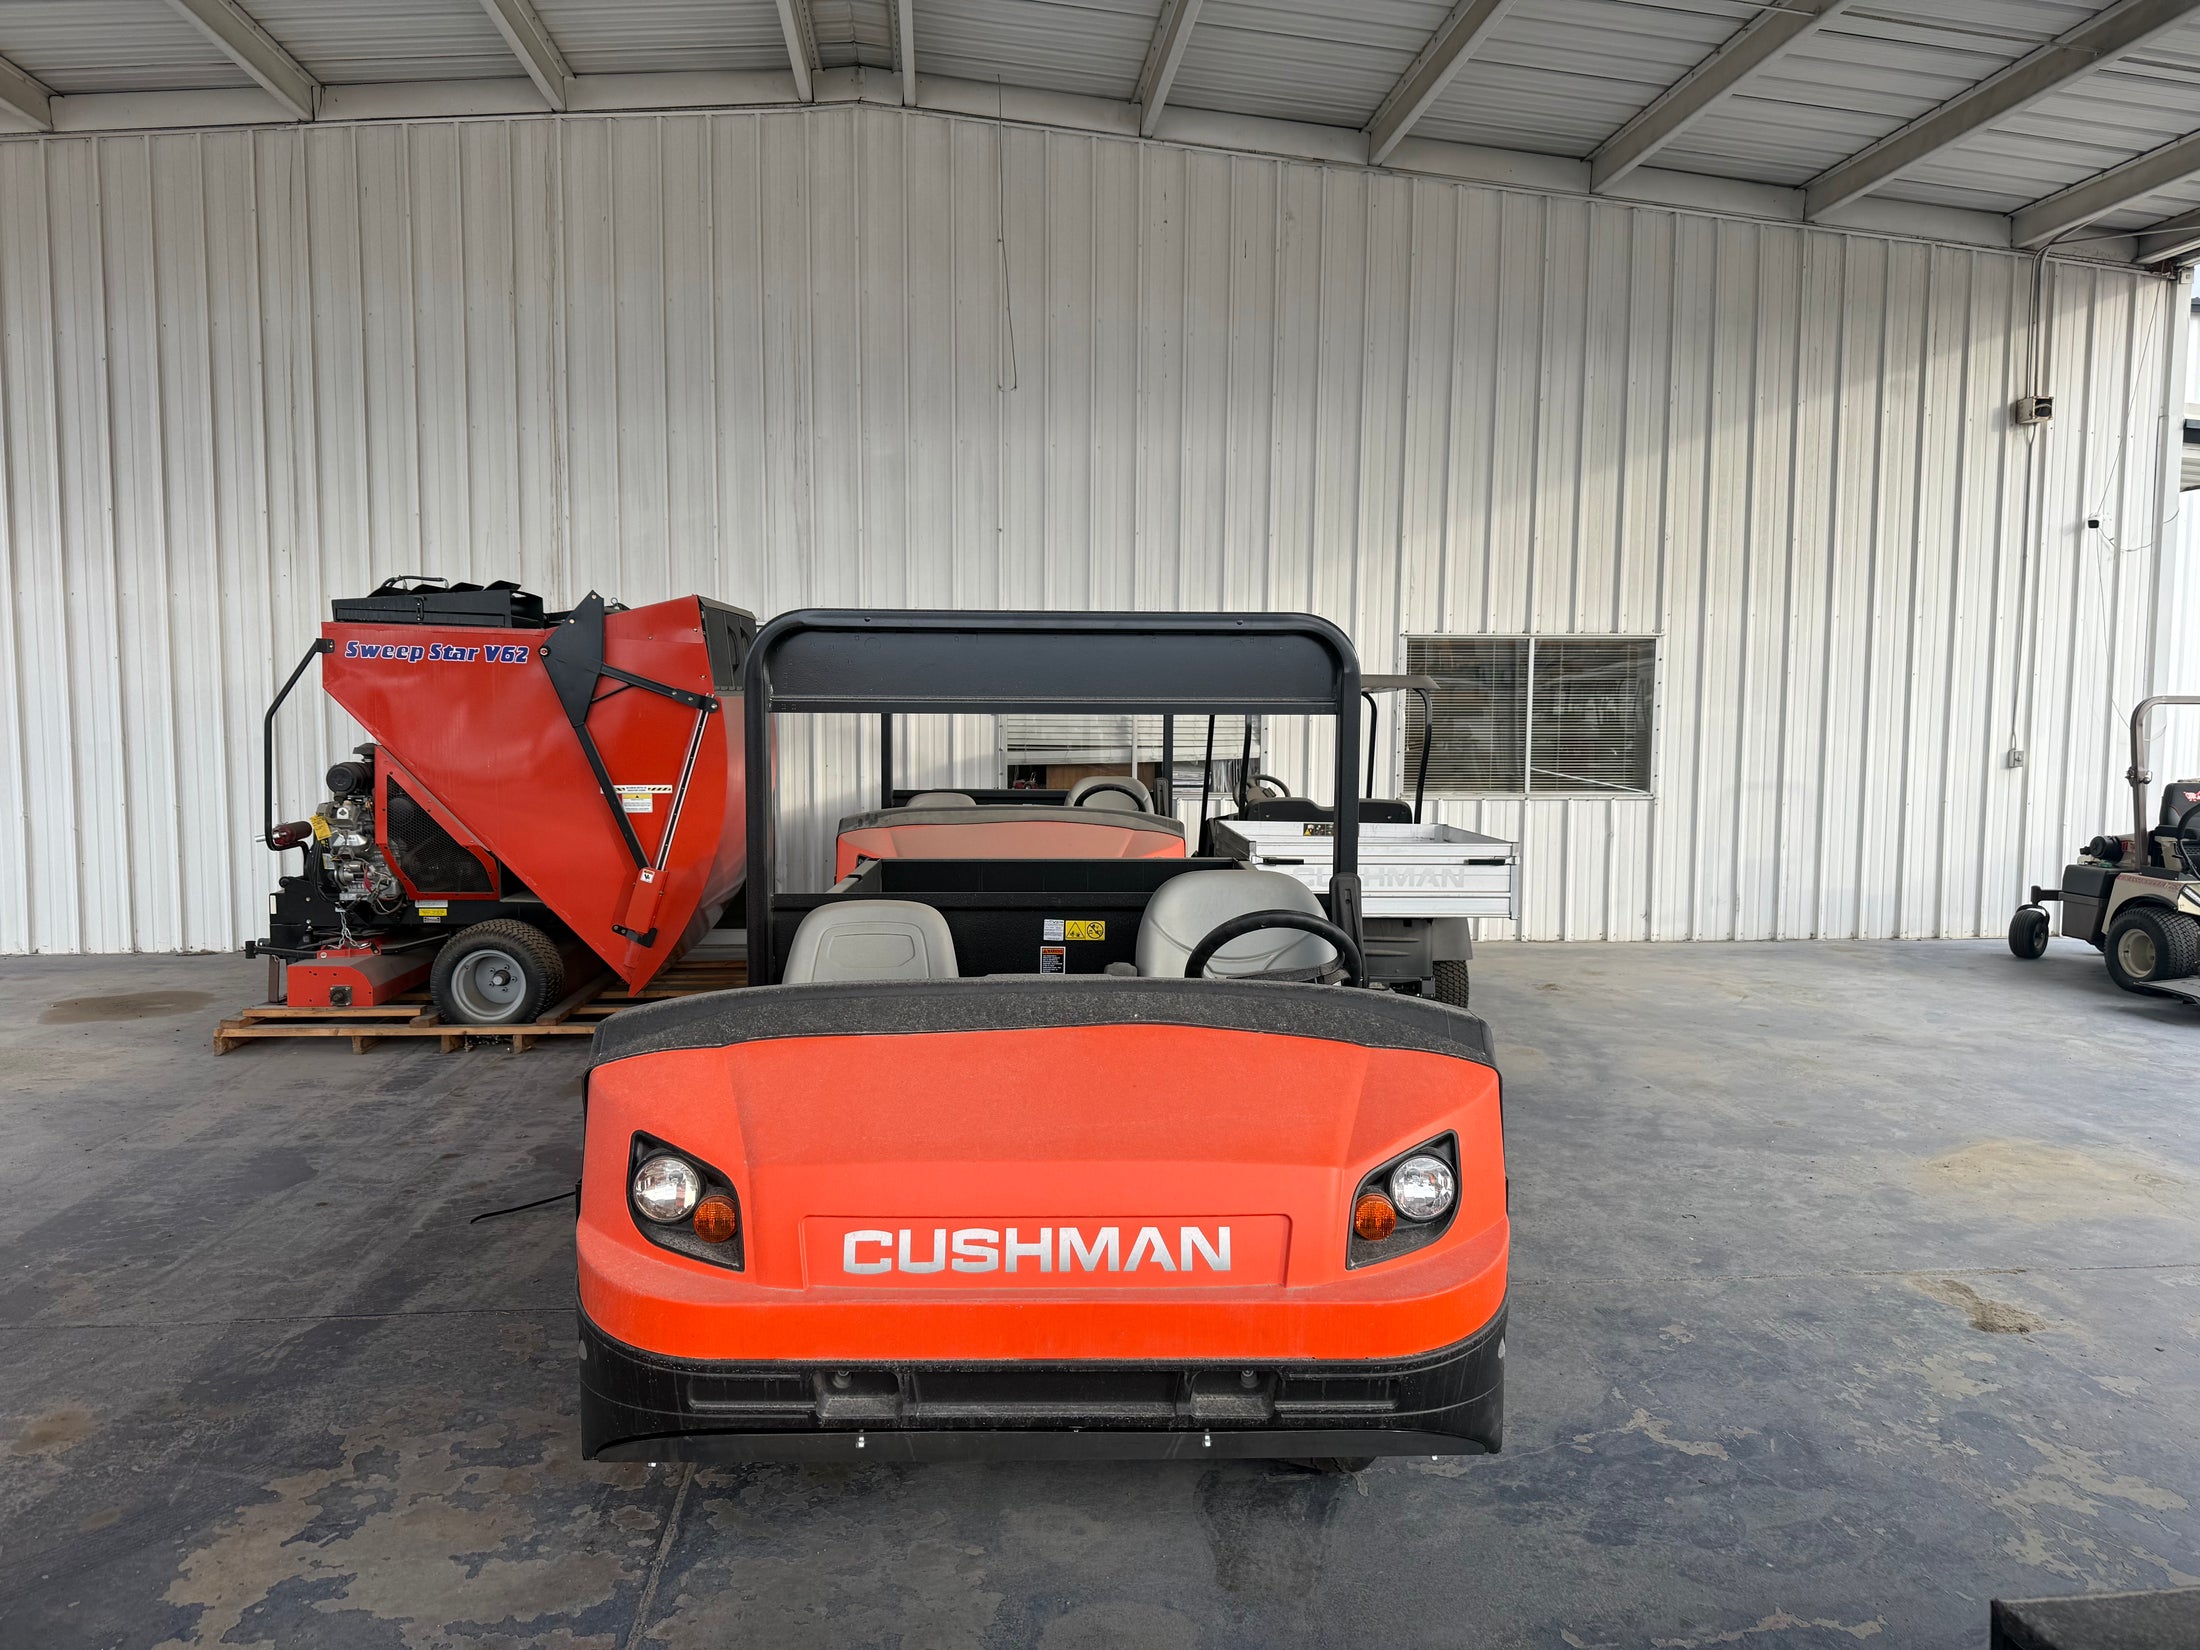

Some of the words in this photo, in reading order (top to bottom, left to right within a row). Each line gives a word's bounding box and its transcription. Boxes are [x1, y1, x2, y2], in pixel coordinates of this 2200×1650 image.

[345, 640, 424, 663] Sweep
[428, 643, 480, 662] Star
[484, 644, 530, 664] V62
[1292, 867, 1465, 888] CUHMAN
[843, 1226, 1231, 1274] CUSHMAN
